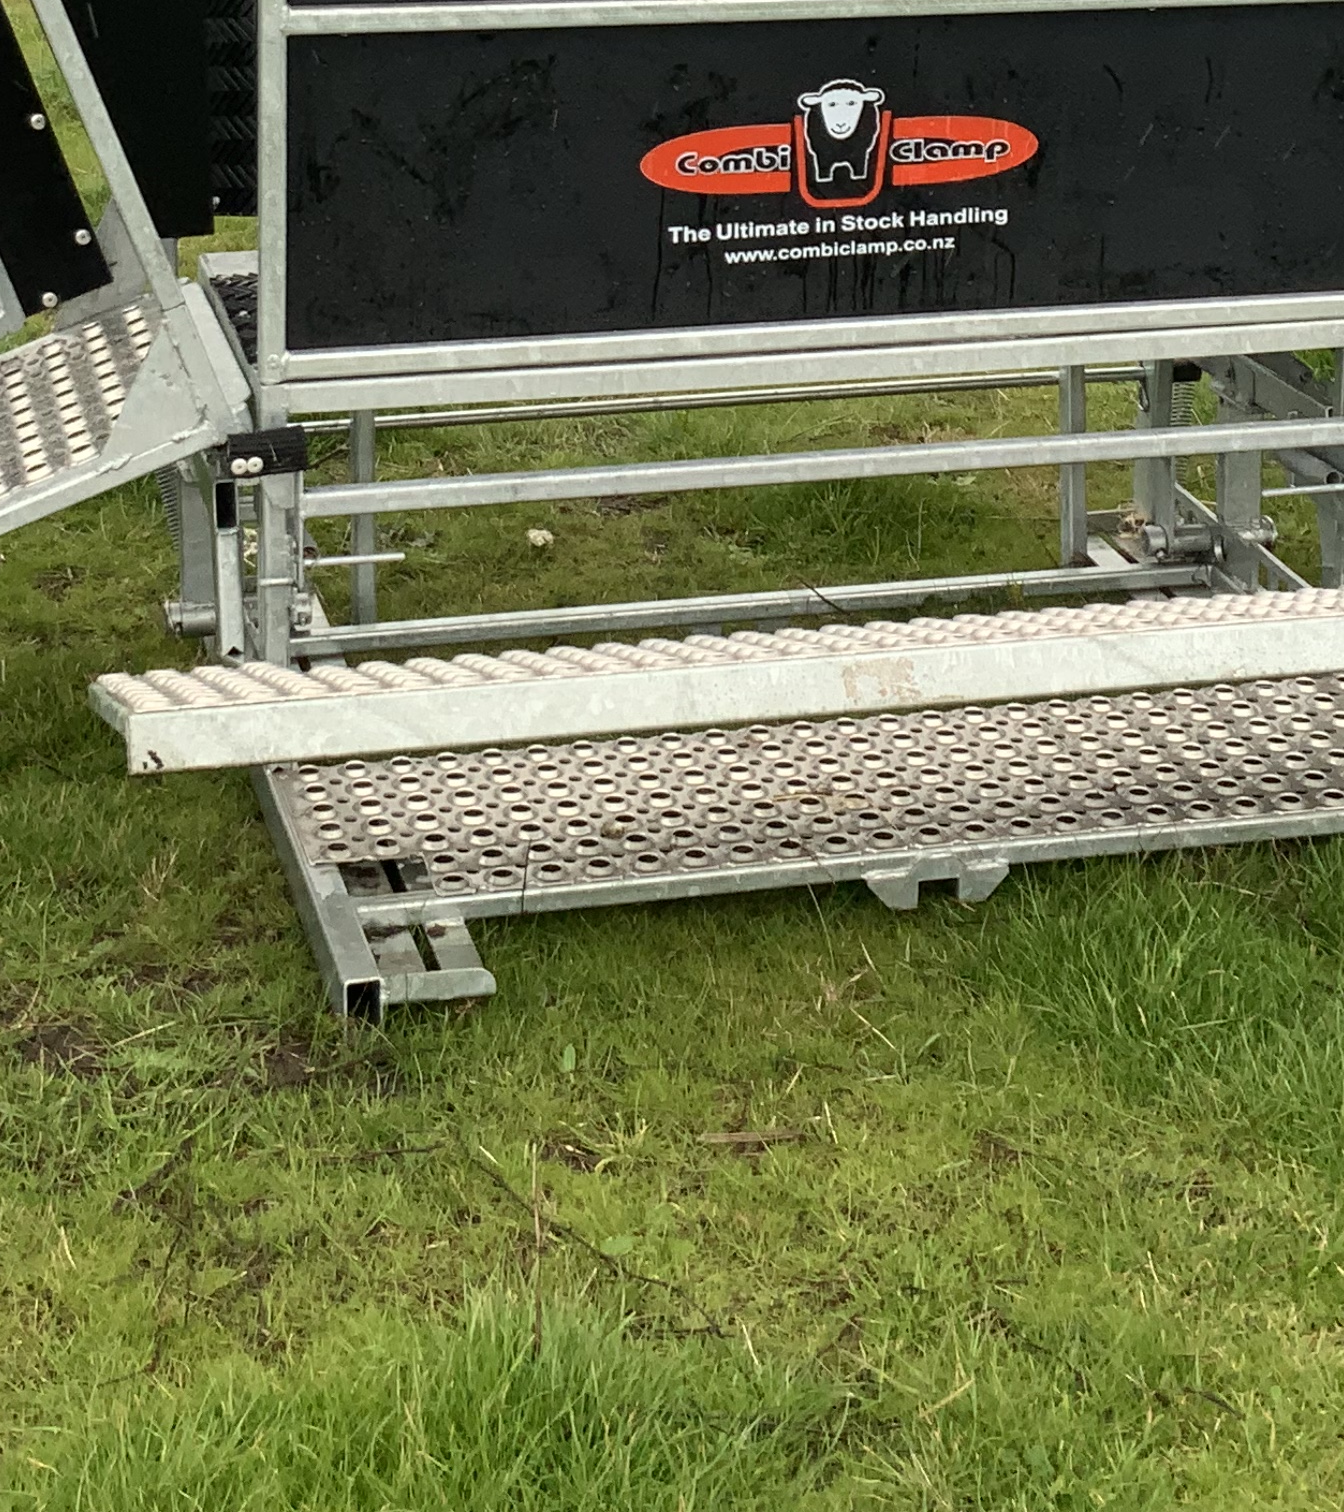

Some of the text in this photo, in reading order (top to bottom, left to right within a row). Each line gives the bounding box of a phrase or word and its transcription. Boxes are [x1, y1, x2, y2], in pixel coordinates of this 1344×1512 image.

[674, 138, 1011, 176] Combi Clamp
[668, 206, 1010, 244] The Ultimate in Stock Handling
[724, 237, 956, 265] www.combiclamp.co.nz
